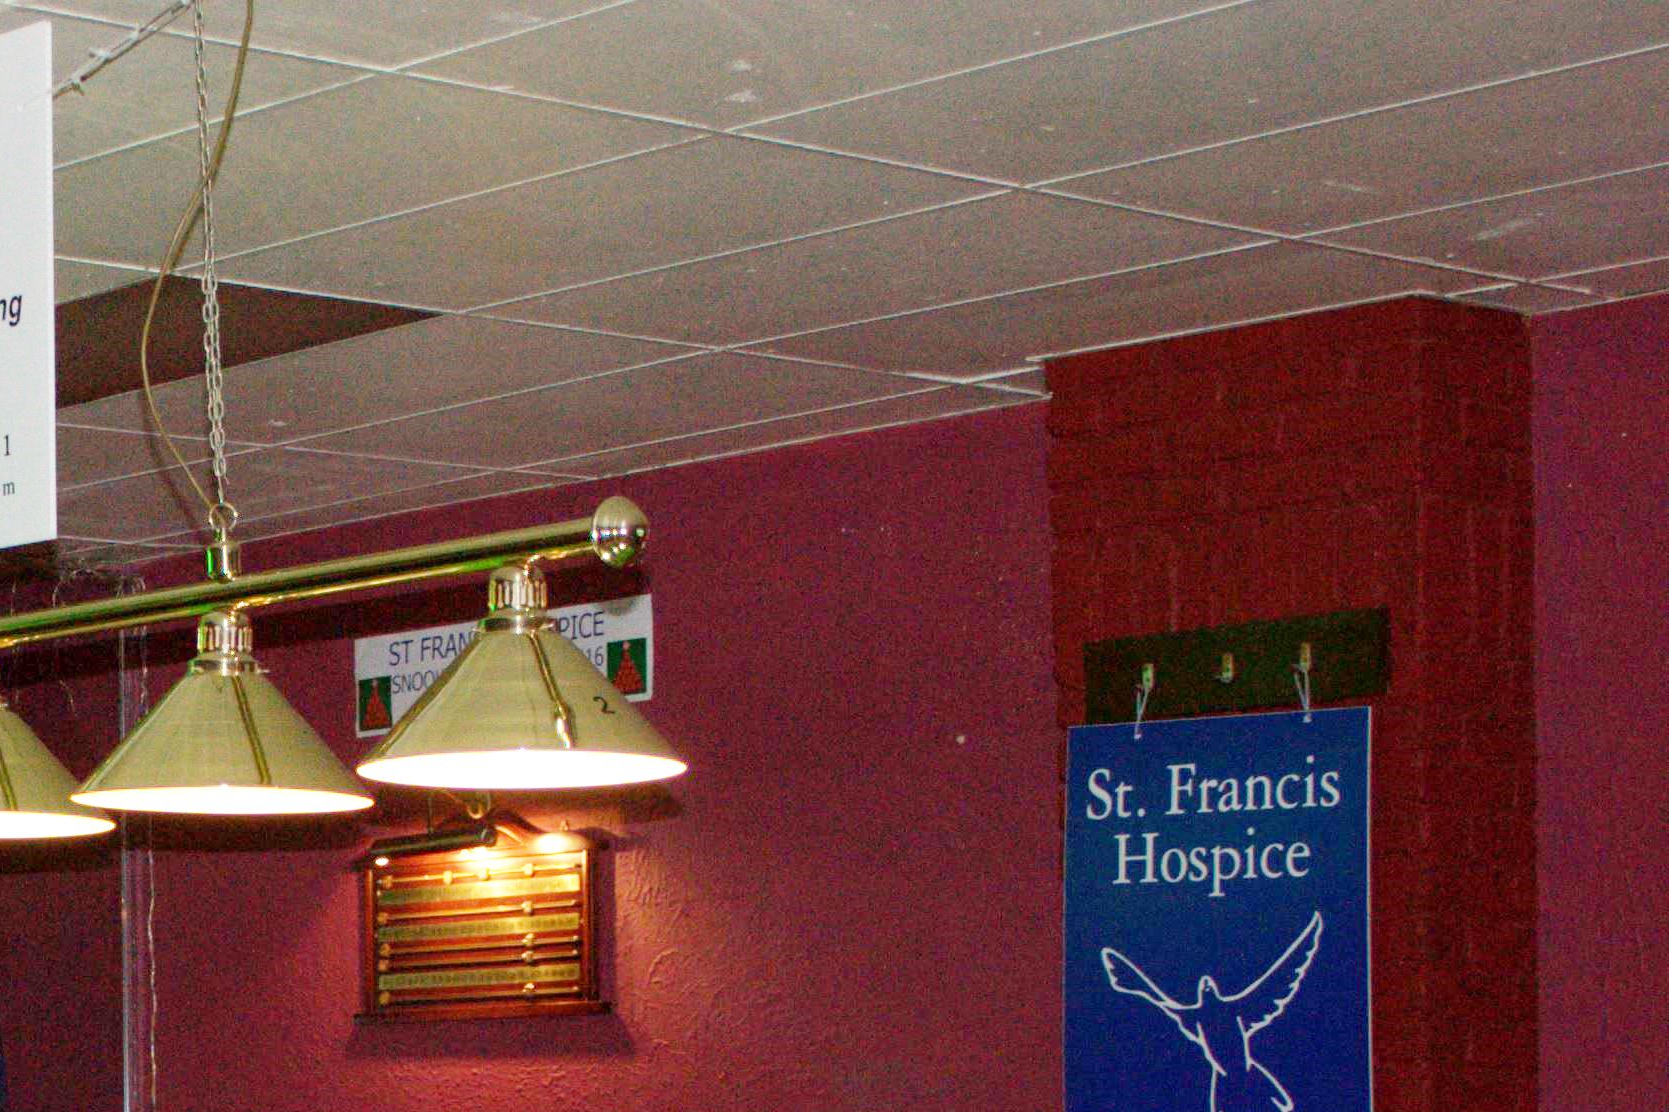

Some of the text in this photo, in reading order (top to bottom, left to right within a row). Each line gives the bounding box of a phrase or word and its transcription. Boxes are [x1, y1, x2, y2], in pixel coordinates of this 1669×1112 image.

[389, 611, 605, 666] ST FRAN PICE
[391, 645, 604, 694] SNOO 16
[1085, 754, 1341, 821] St. Francis
[1111, 827, 1312, 897] Hospice
